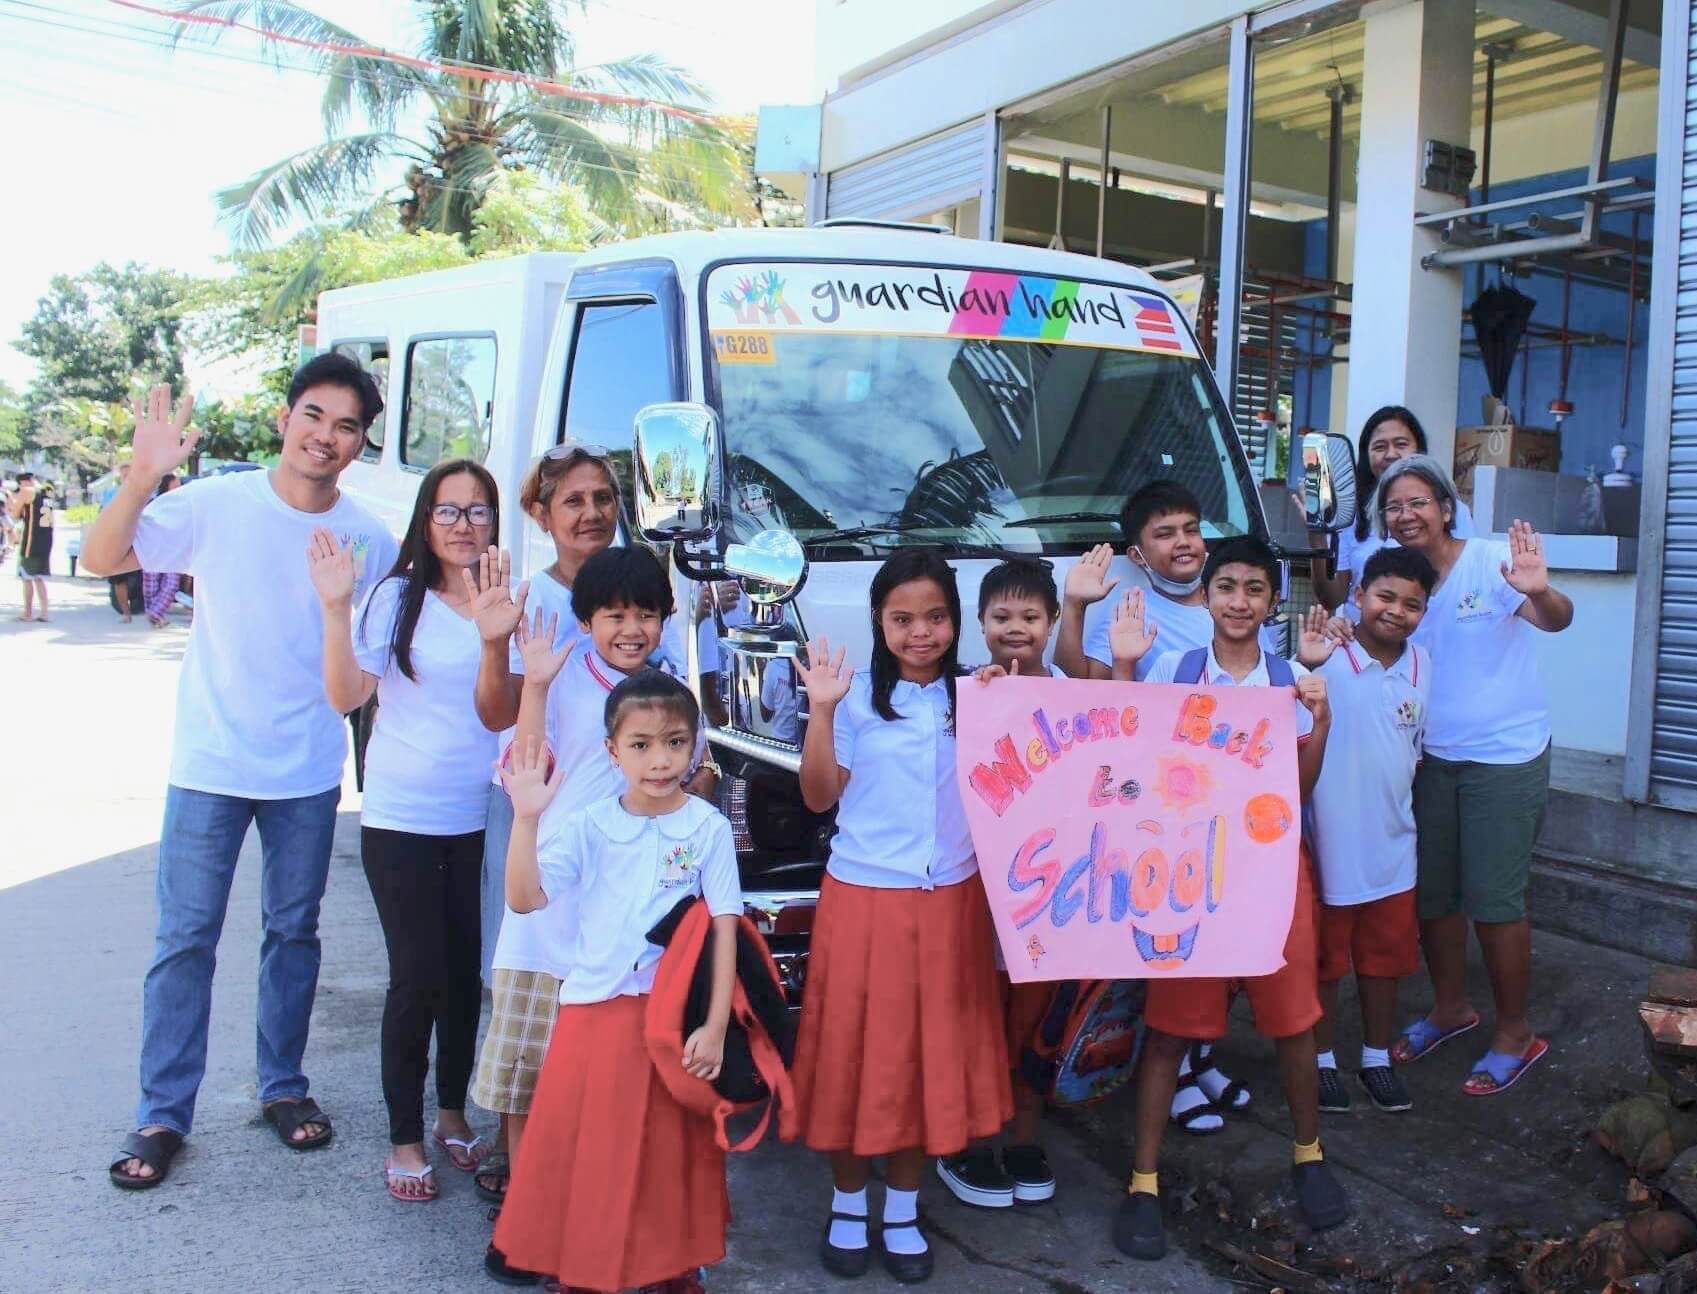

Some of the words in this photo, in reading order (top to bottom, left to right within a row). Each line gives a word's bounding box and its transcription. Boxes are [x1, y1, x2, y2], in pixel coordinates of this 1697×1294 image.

[811, 273, 1010, 323] guardian
[1018, 280, 1126, 329] hand
[969, 705, 1139, 818] Welcome
[1171, 693, 1274, 769] Back
[1008, 815, 1227, 930] School
